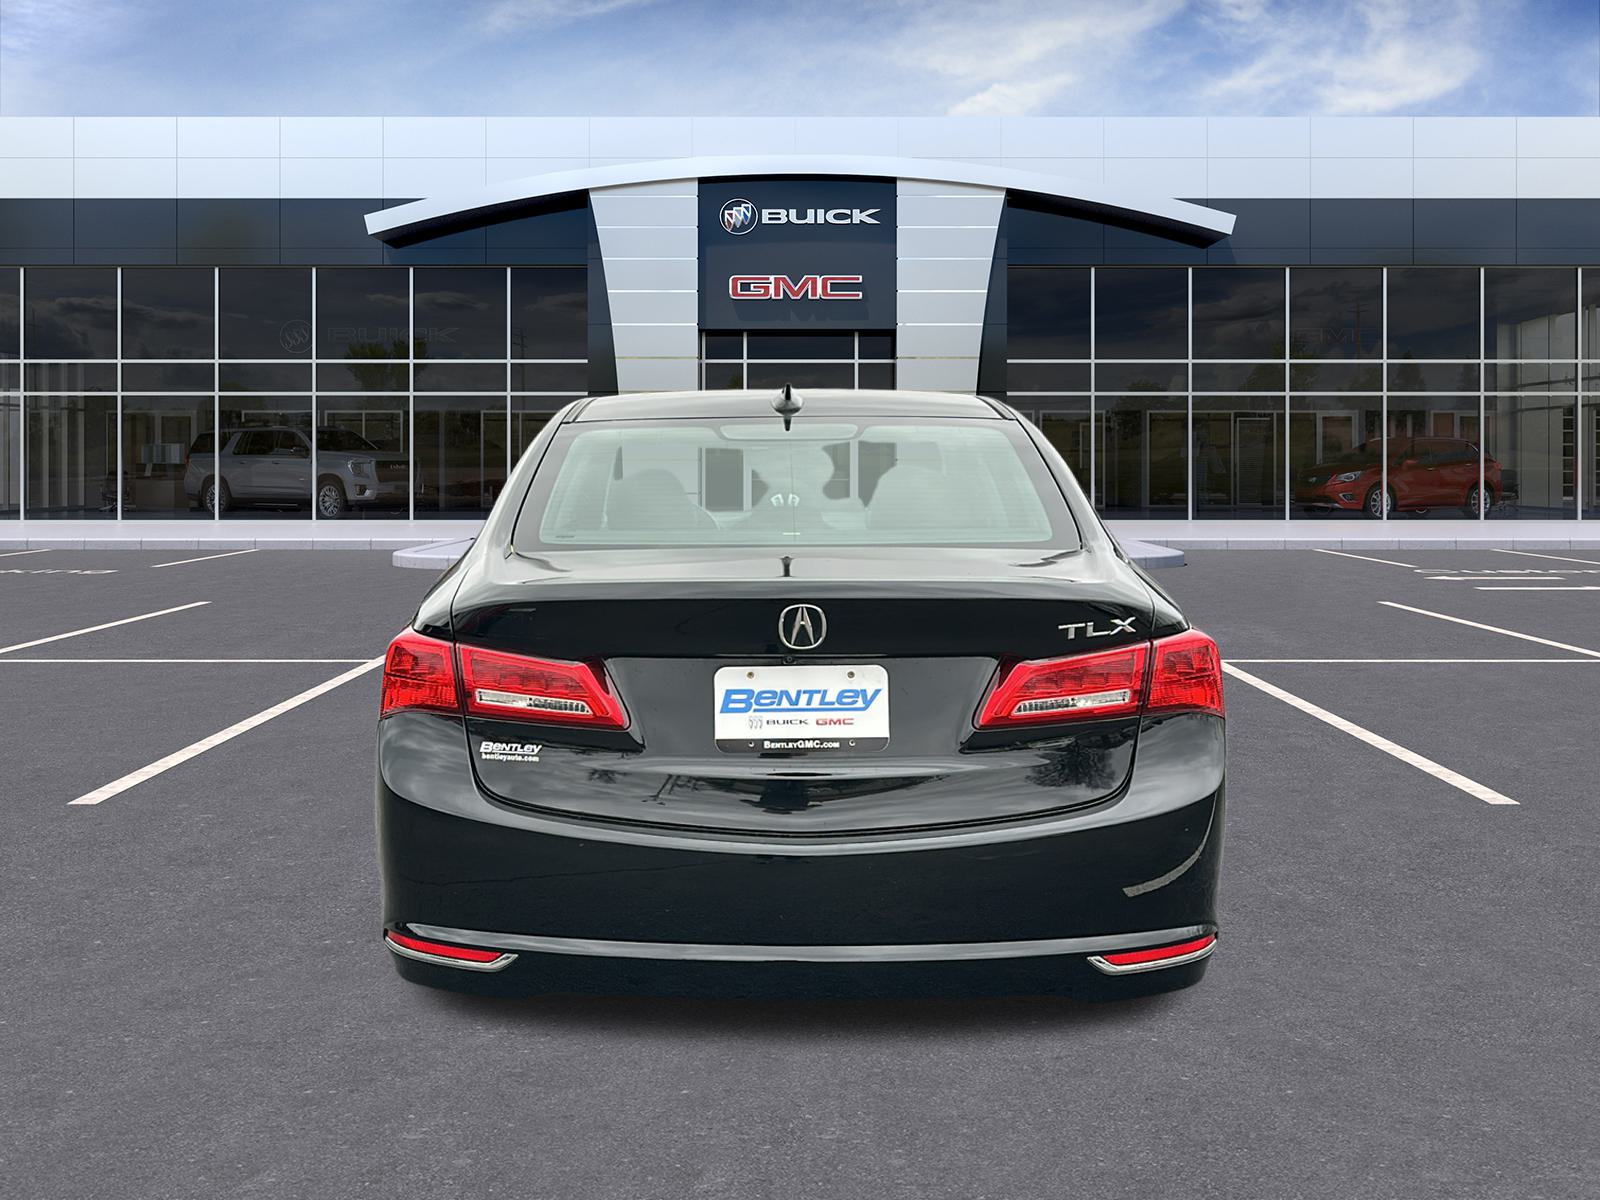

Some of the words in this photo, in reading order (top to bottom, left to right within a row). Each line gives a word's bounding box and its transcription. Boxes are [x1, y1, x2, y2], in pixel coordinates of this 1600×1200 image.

[761, 208, 881, 224] BUICK
[729, 274, 862, 299] GMC
[328, 327, 460, 343] BUICK
[1058, 616, 1136, 639] TLX
